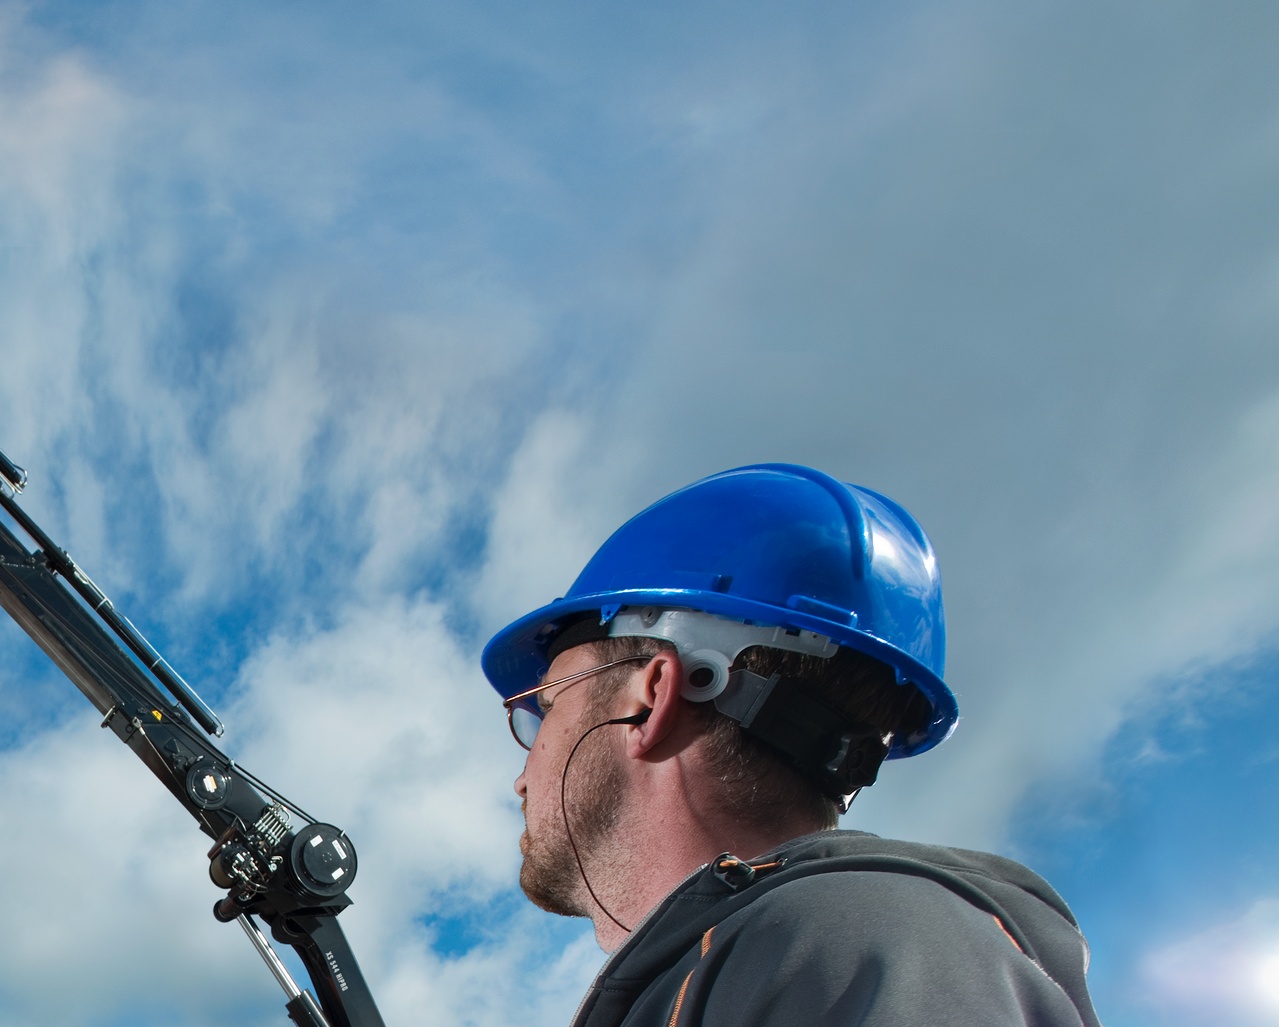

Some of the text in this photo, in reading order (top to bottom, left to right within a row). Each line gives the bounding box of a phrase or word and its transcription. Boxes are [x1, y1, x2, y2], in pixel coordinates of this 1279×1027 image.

[325, 950, 349, 992] XS 544 HIPRO
